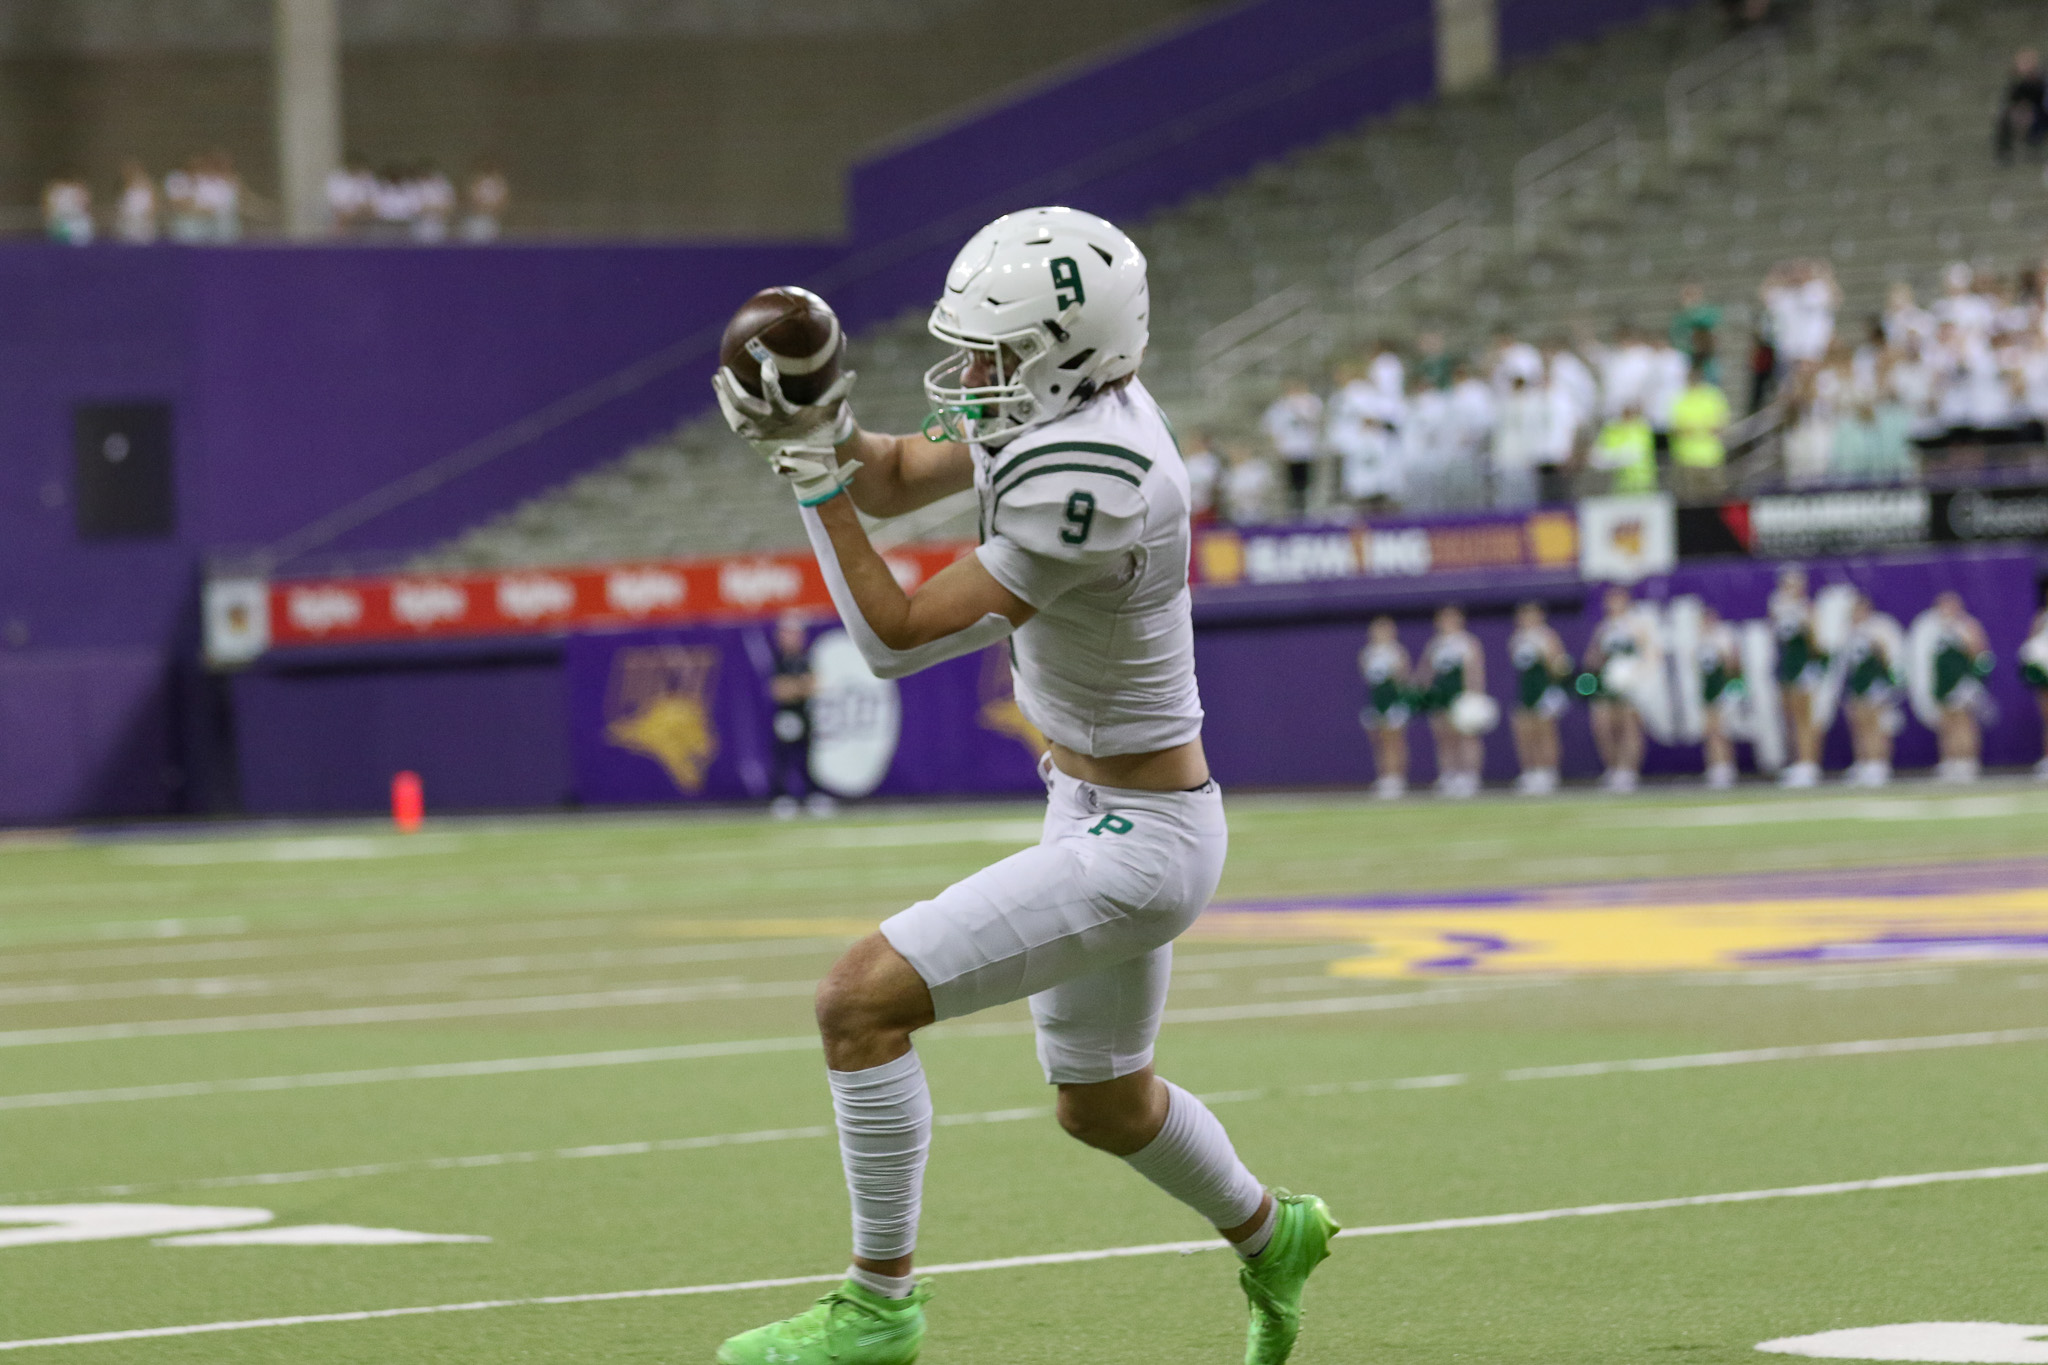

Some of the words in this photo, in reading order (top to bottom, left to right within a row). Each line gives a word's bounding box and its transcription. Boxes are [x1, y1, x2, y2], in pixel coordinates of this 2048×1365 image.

[1050, 256, 1086, 311] 9
[1060, 489, 1096, 547] 9
[1087, 813, 1134, 836] P
